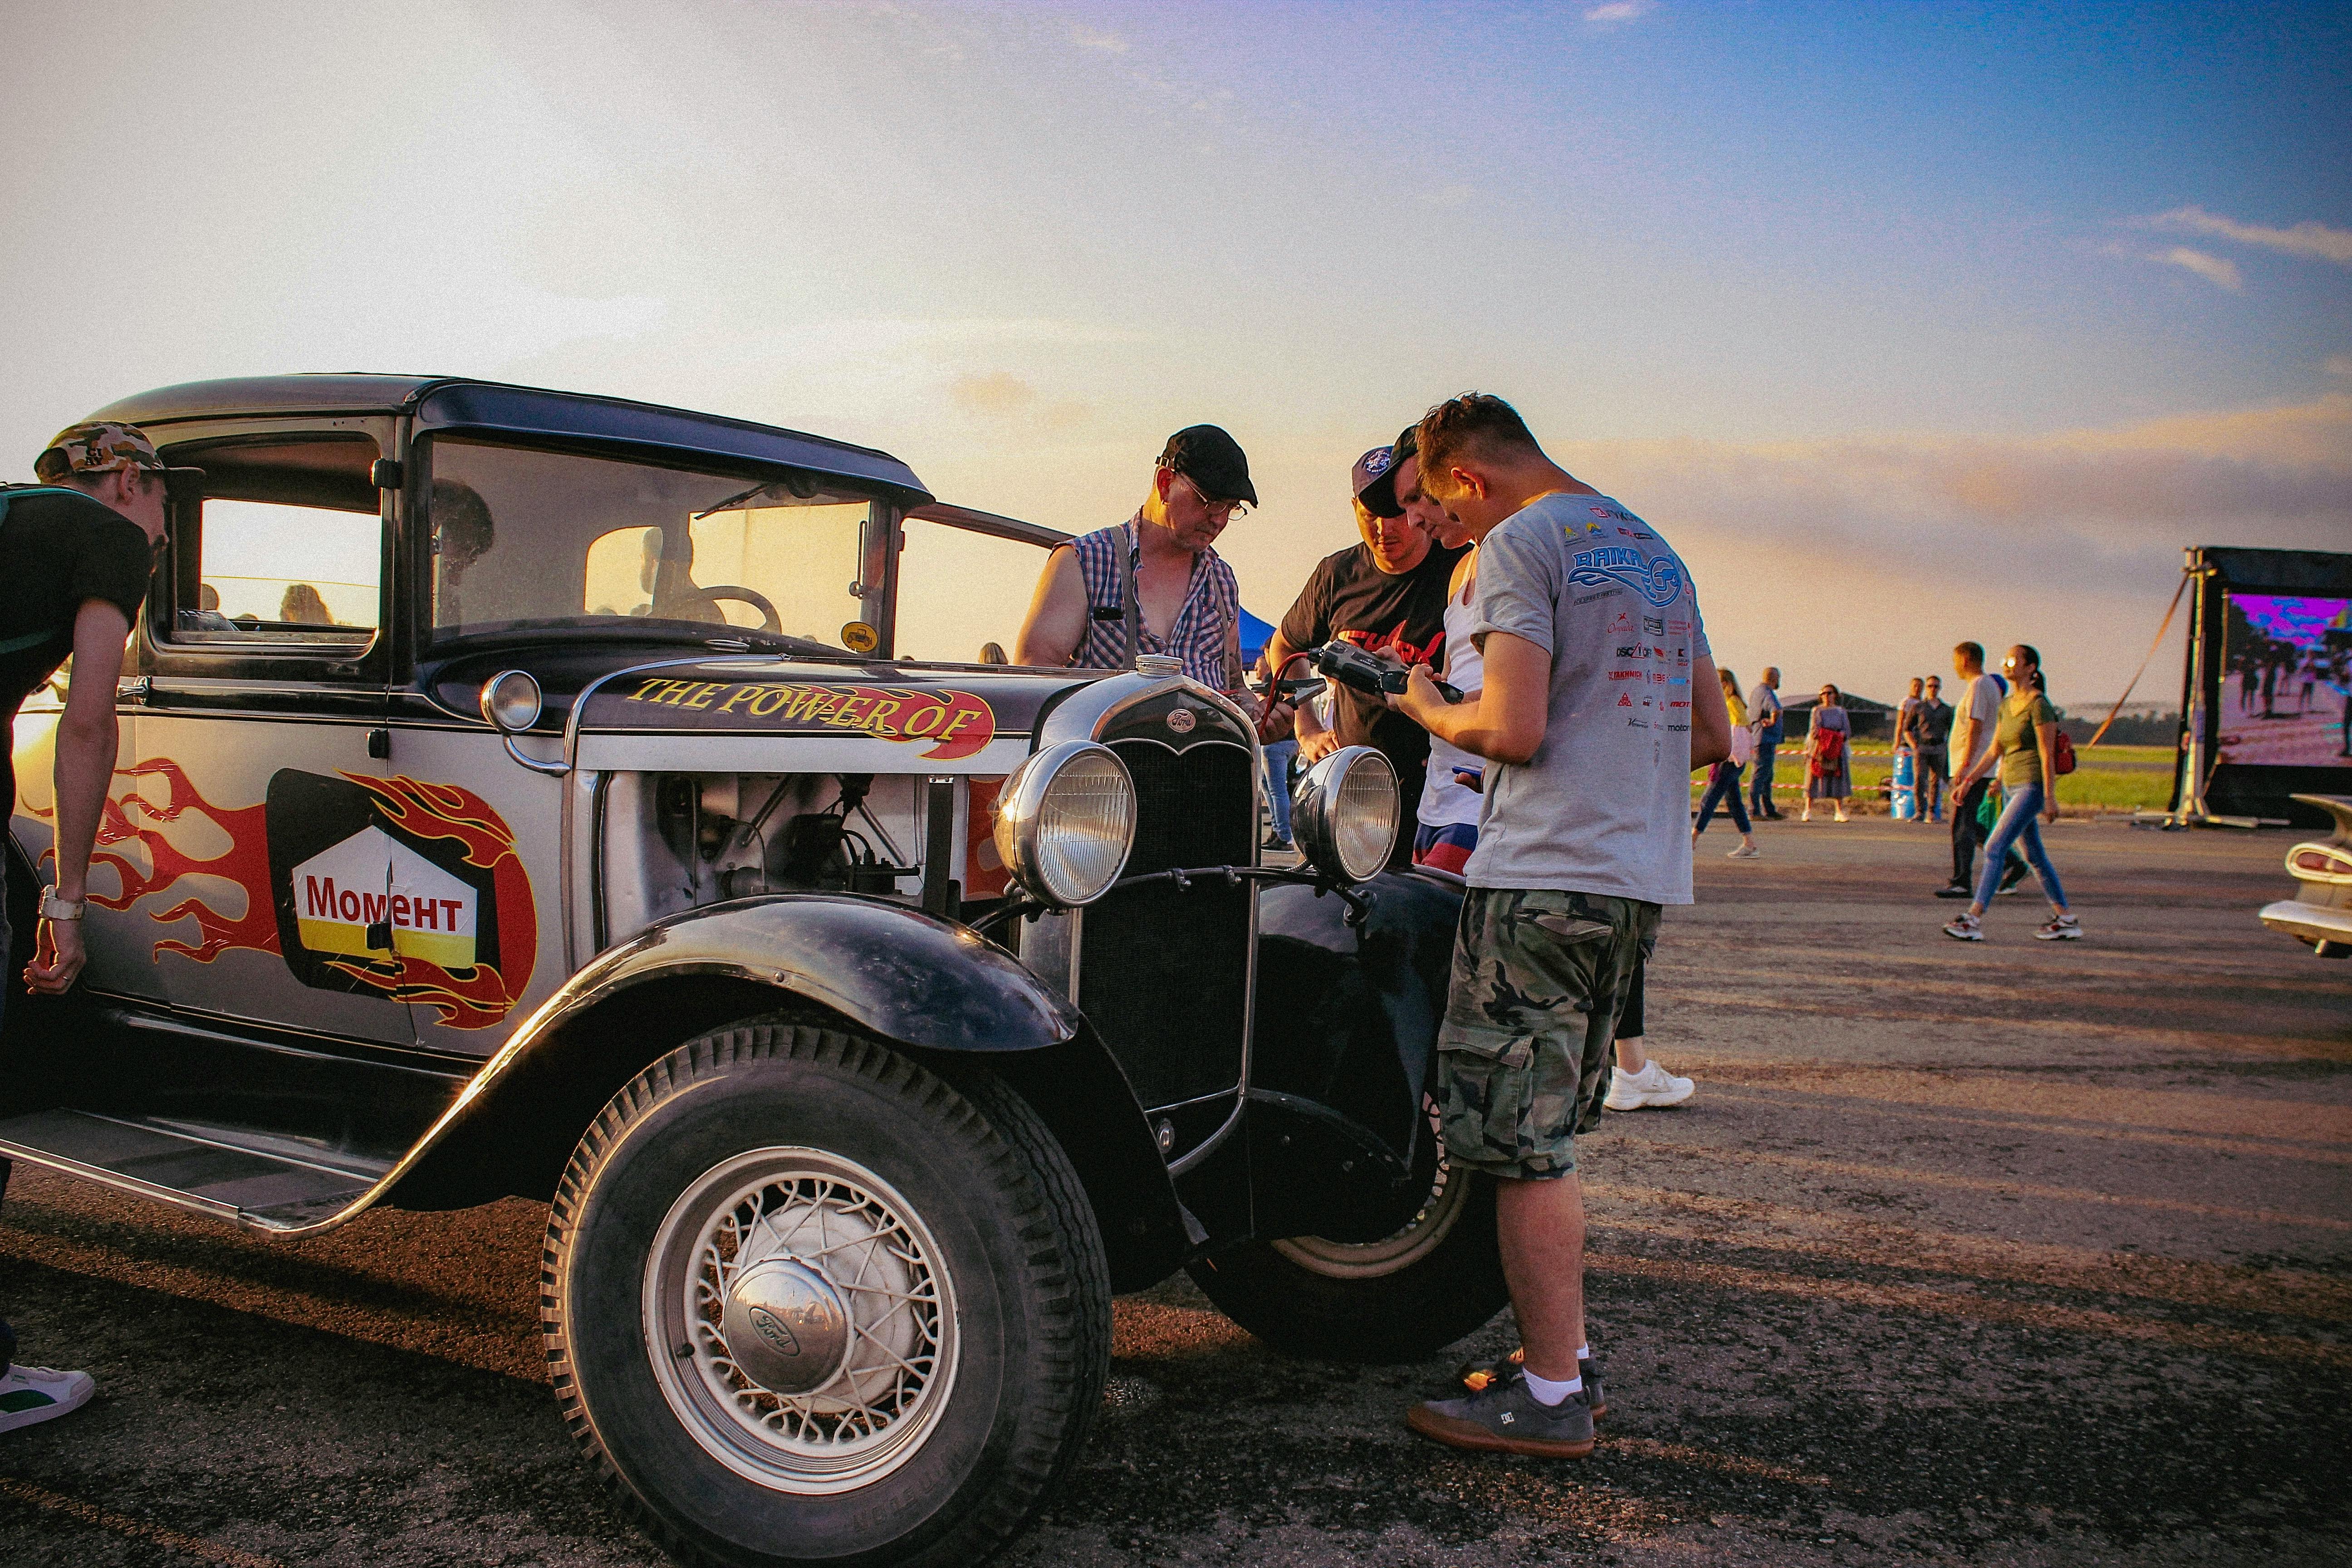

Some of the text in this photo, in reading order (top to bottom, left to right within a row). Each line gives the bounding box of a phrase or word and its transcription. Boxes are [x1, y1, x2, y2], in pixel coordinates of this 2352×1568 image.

[627, 678, 982, 741] THE POWER OF
[1172, 712, 1191, 726] Ford
[307, 875, 462, 931] Момент
[756, 1316, 791, 1348] Ford
